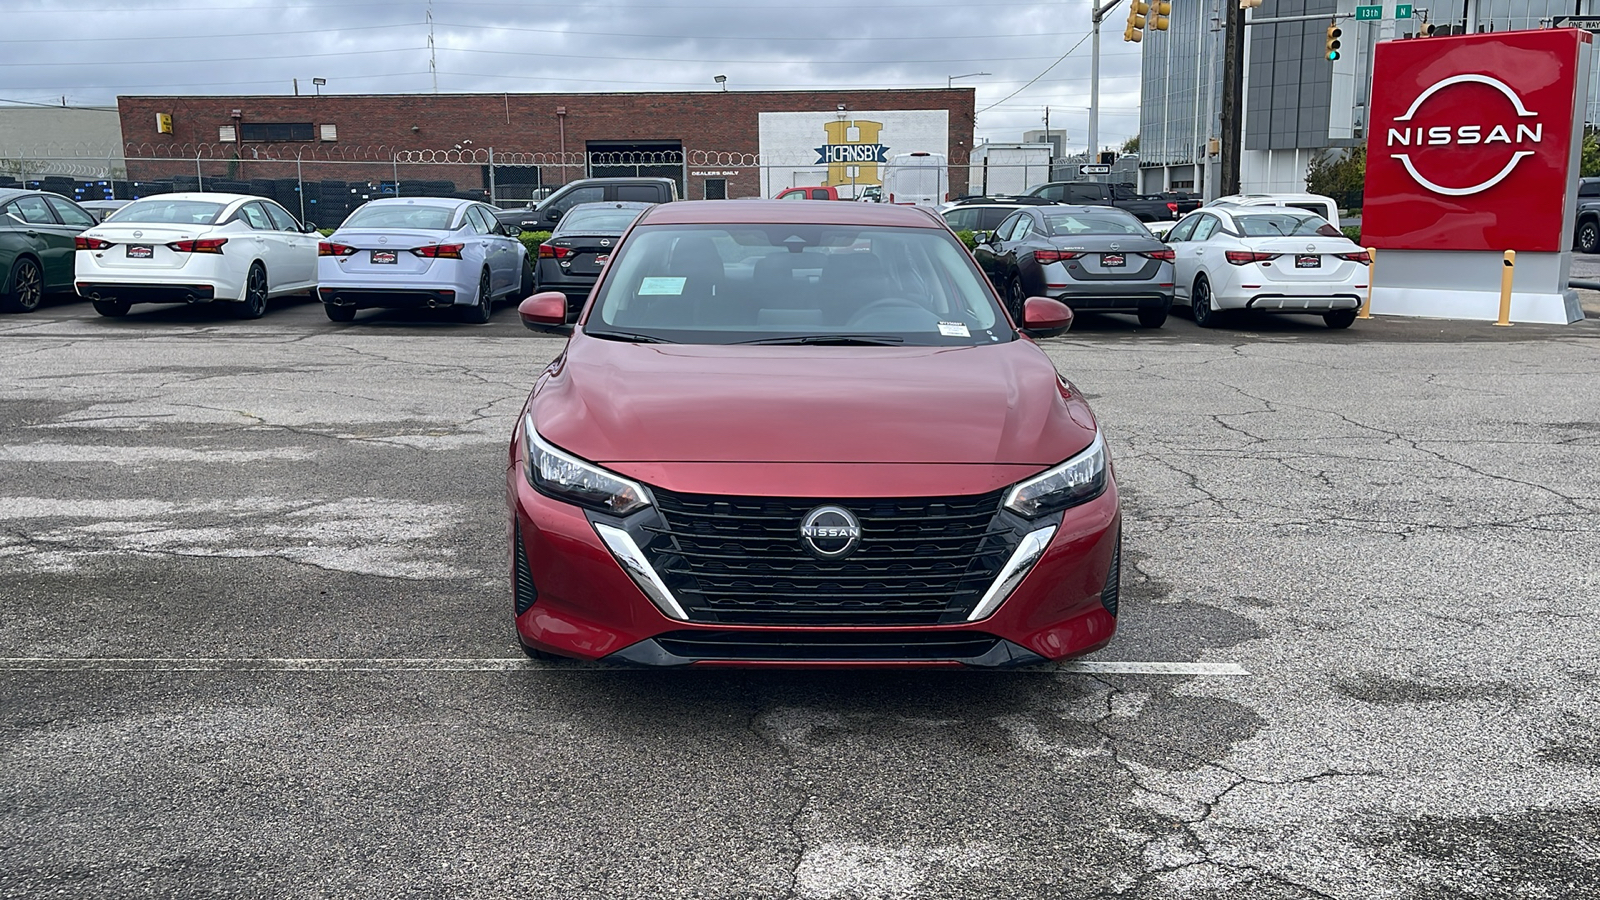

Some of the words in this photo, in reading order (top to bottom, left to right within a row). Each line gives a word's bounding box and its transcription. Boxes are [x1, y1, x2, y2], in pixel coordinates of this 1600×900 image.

[1362, 9, 1379, 17] 13th
[1400, 7, 1406, 16] N
[1568, 21, 1583, 29] ONE
[1585, 21, 1600, 29] WAY
[1387, 123, 1543, 147] NISSAN
[825, 145, 881, 163] HORNSBY
[802, 528, 859, 537] NISSAN
